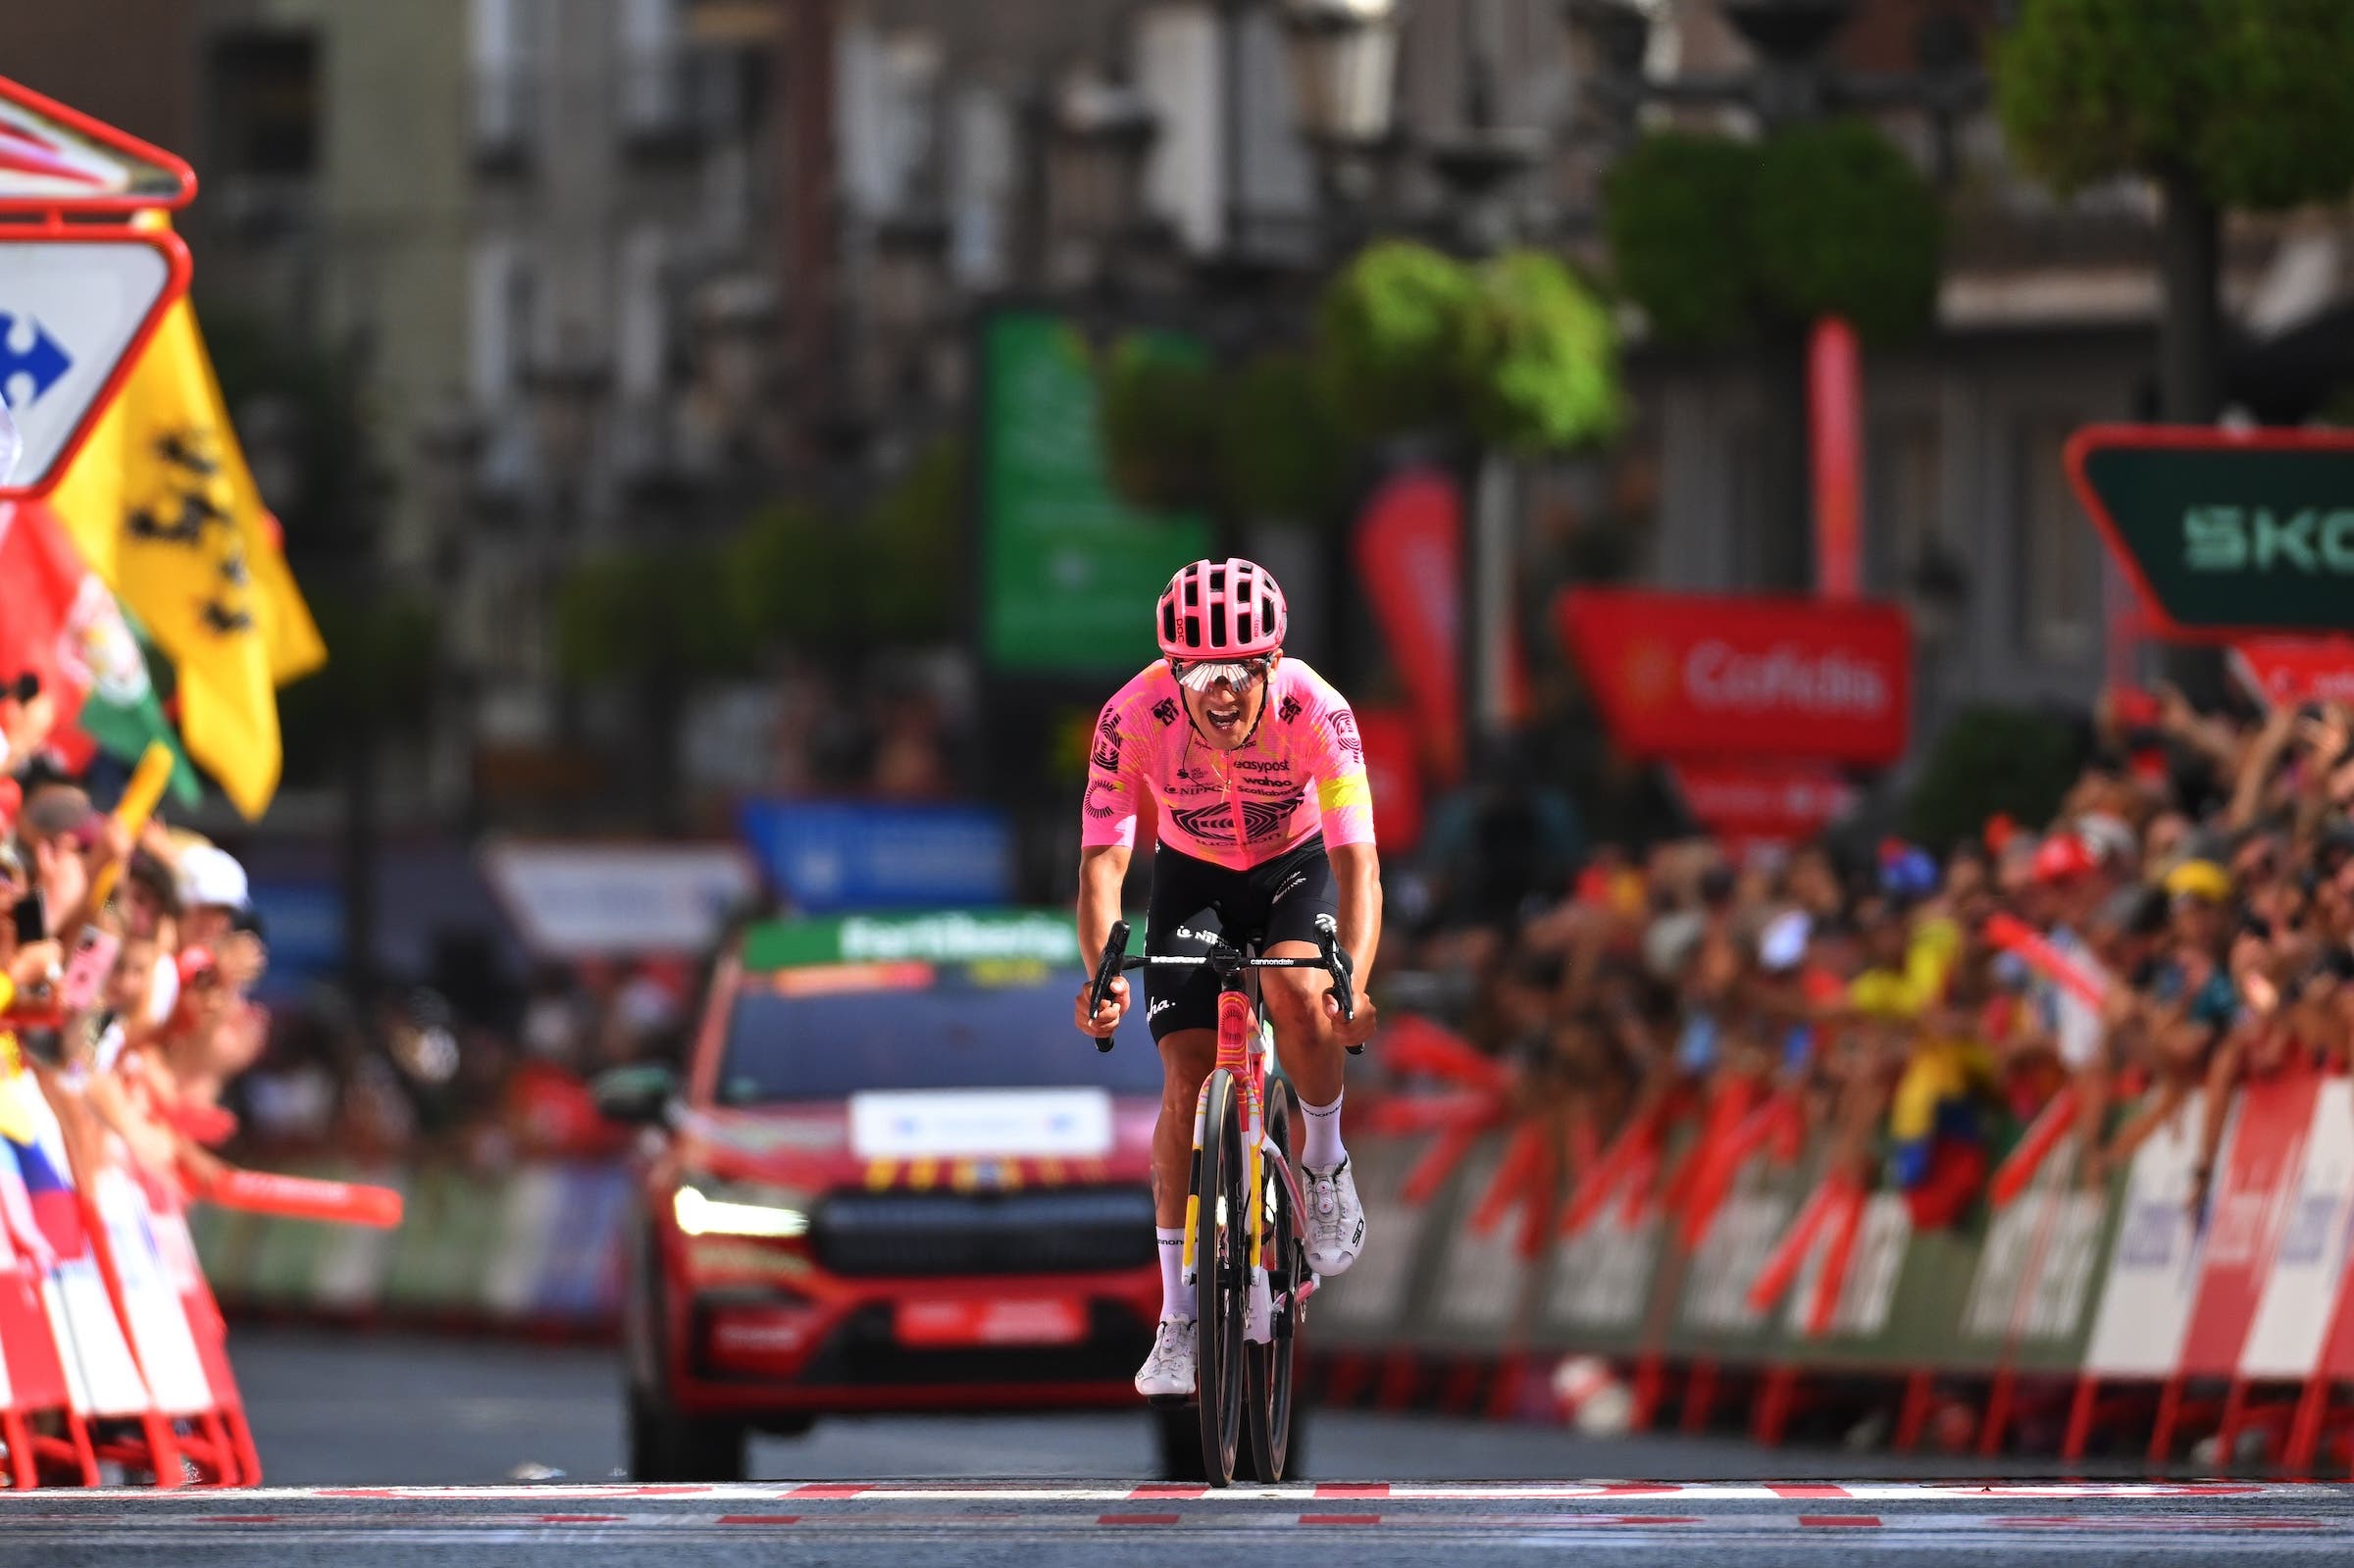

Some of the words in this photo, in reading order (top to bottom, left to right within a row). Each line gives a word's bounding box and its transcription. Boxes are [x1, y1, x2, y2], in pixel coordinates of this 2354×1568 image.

[1682, 639, 1889, 718] Cofidis
[1233, 759, 1291, 774] easypost
[1243, 776, 1293, 787] wahoo
[1237, 784, 1301, 797] Scotiabank
